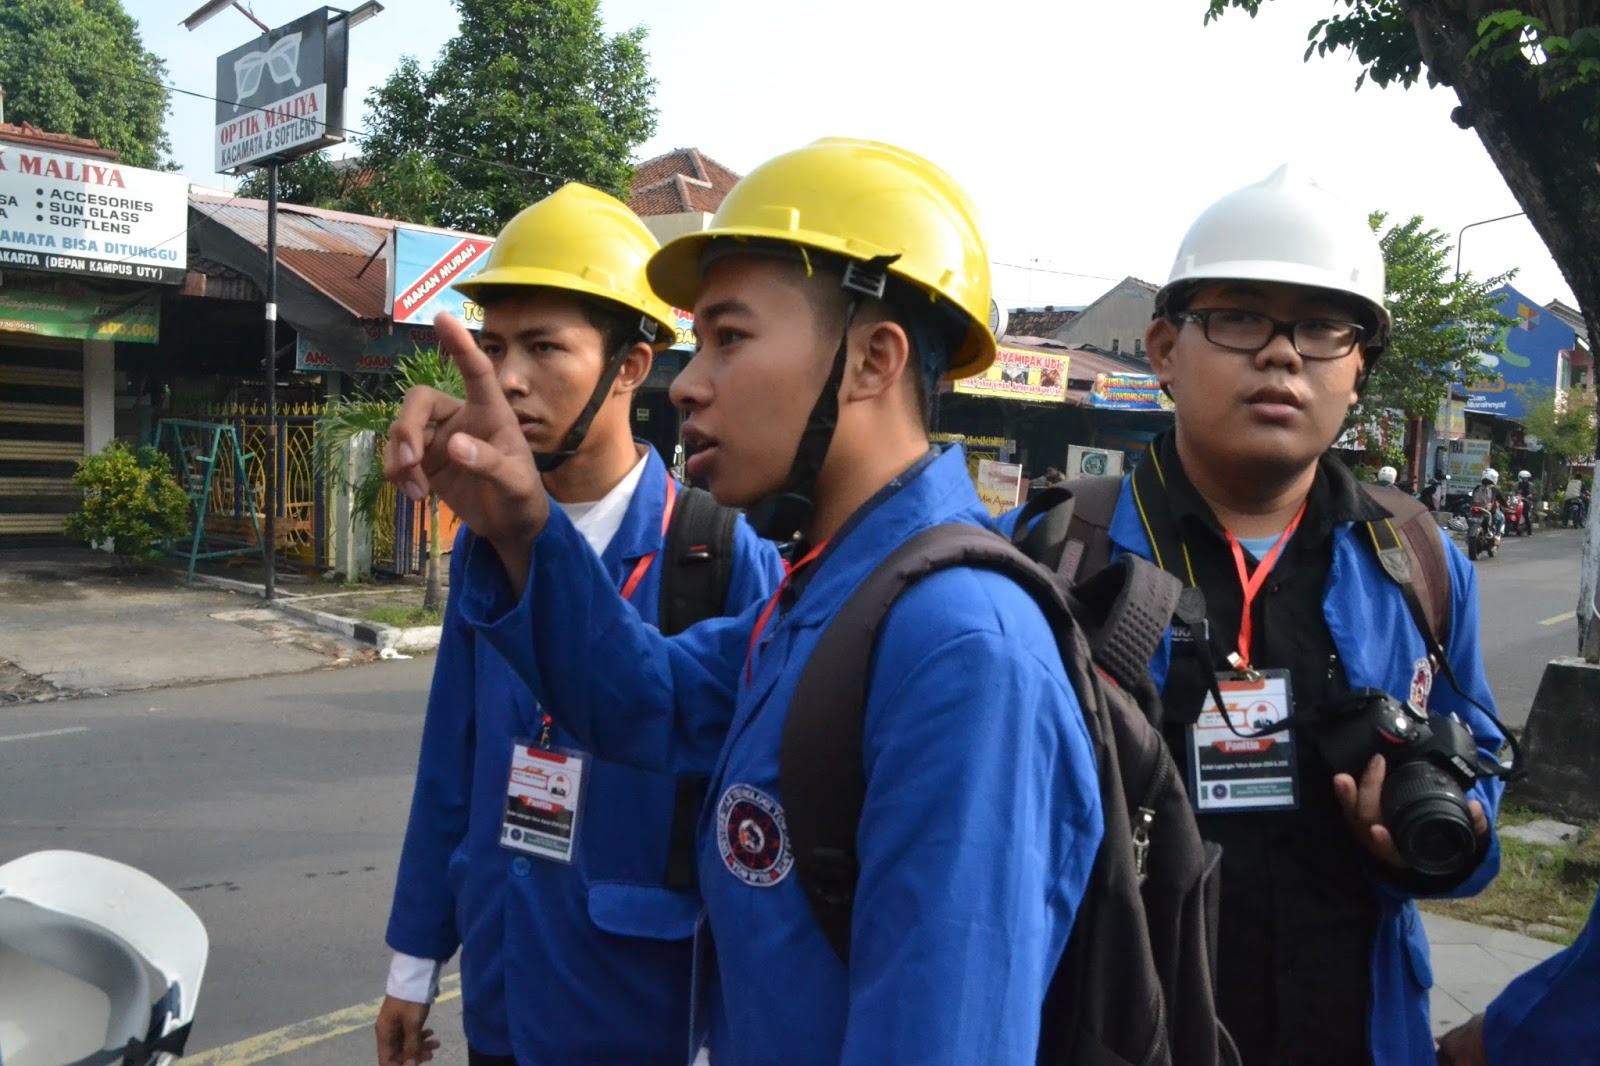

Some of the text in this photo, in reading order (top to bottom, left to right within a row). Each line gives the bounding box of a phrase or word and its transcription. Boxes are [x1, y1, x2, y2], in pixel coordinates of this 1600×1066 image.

[221, 92, 318, 145] OPTIK MALIYA
[222, 115, 316, 166] KACAMATA & SOFTLENS
[18, 153, 126, 188] MALIYA
[50, 188, 153, 212] ACCESORIES
[50, 202, 139, 223] SUN GLASS
[50, 215, 131, 235] SOFTLENS
[62, 237, 99, 252] BISA
[104, 242, 178, 262] DITUNGGU
[45, 255, 85, 270] (DEPAN
[89, 260, 133, 275] KAMPUS
[137, 265, 163, 280] UTY)
[402, 244, 477, 310] MAKAN MURAH
